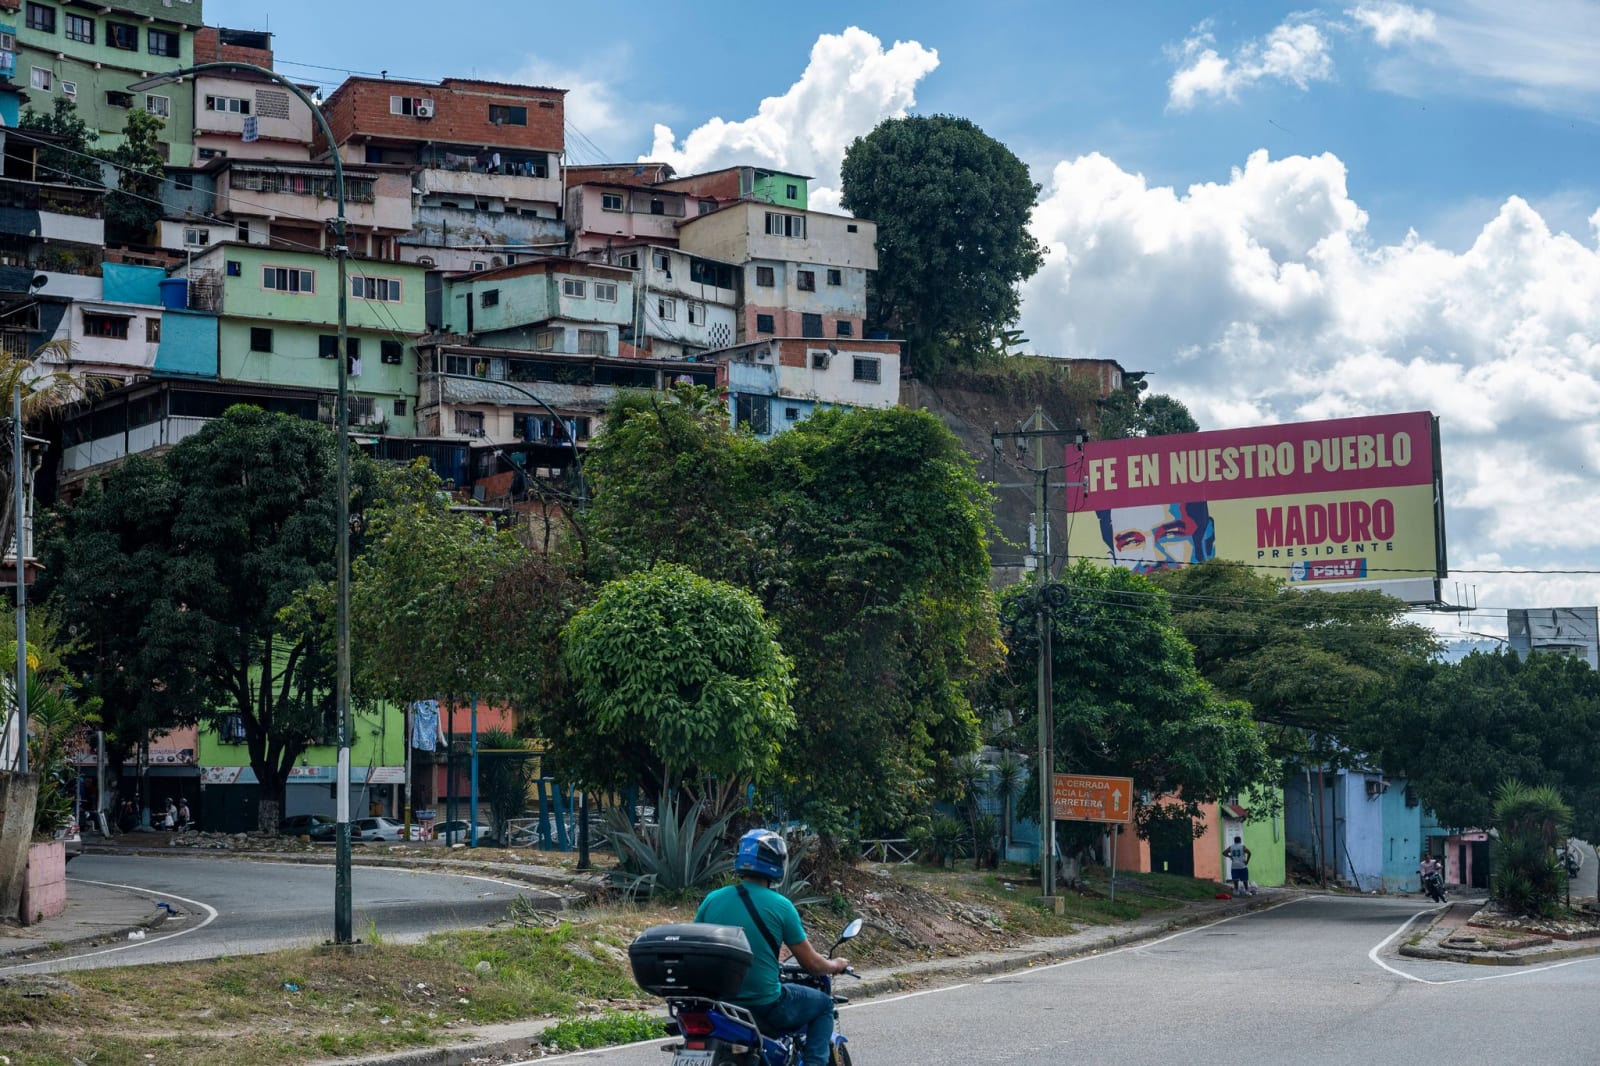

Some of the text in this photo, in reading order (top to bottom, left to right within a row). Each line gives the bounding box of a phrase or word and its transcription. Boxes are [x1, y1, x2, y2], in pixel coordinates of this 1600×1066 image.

[1089, 431, 1412, 492] FE EN NUESTRO PUEBLO
[1256, 499, 1395, 548] MADURO
[1257, 543, 1394, 559] PRESIDENTE
[1067, 780, 1110, 790] CERRADA
[1055, 789, 1076, 797] ACIA
[1055, 799, 1103, 808] ARRETERA
